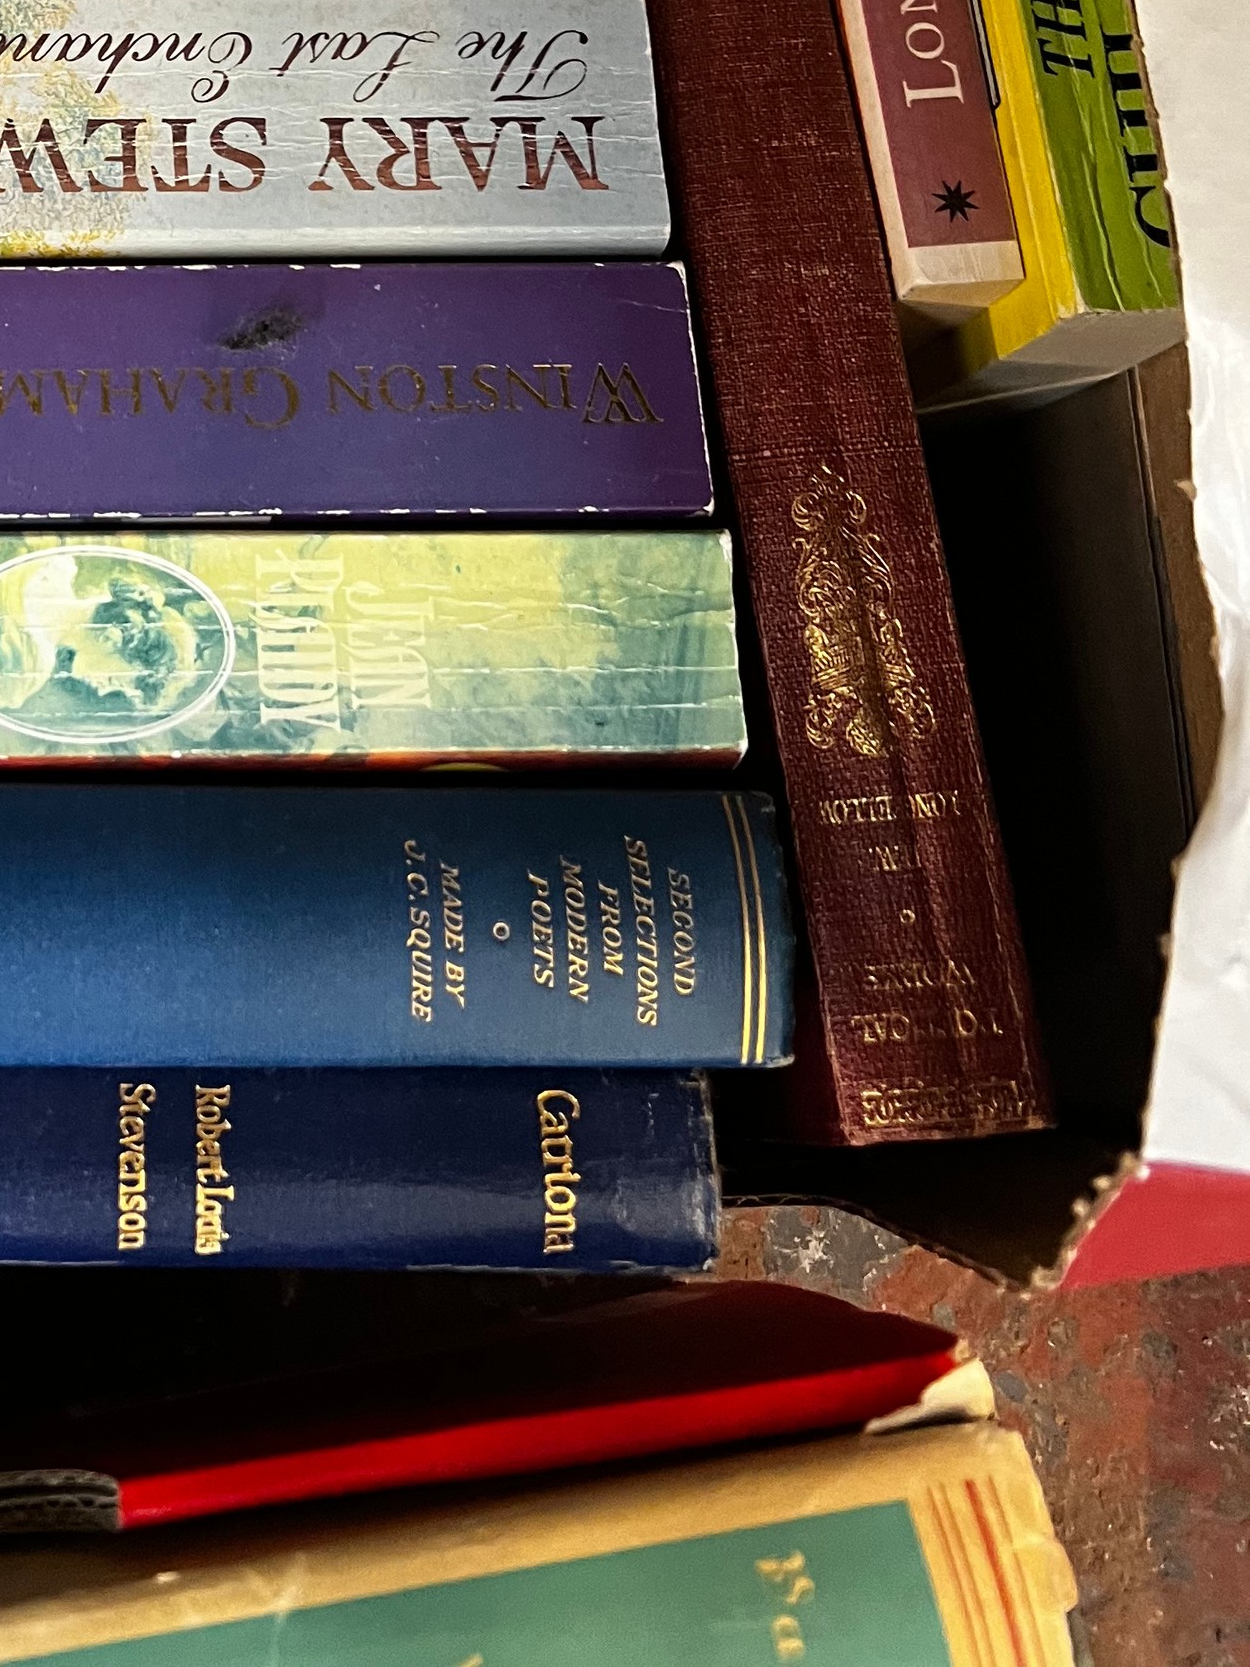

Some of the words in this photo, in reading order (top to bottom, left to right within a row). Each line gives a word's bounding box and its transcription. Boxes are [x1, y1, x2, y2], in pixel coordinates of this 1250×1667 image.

[276, 27, 440, 101] Last
[454, 30, 590, 103] The
[313, 112, 611, 196] MARY
[325, 361, 663, 428] WINSTON
[340, 580, 435, 712] JEAN
[439, 859, 465, 953] MADE
[526, 868, 555, 988] POETS
[558, 854, 590, 1003] MODERN
[598, 878, 625, 976] FROM
[622, 834, 658, 1027] SELECTIONS
[667, 866, 695, 997] SECOND
[444, 960, 466, 1009] BY
[115, 1081, 158, 1251] Stevenson
[195, 1084, 233, 1183] Robert
[536, 1087, 583, 1255] Catriona
